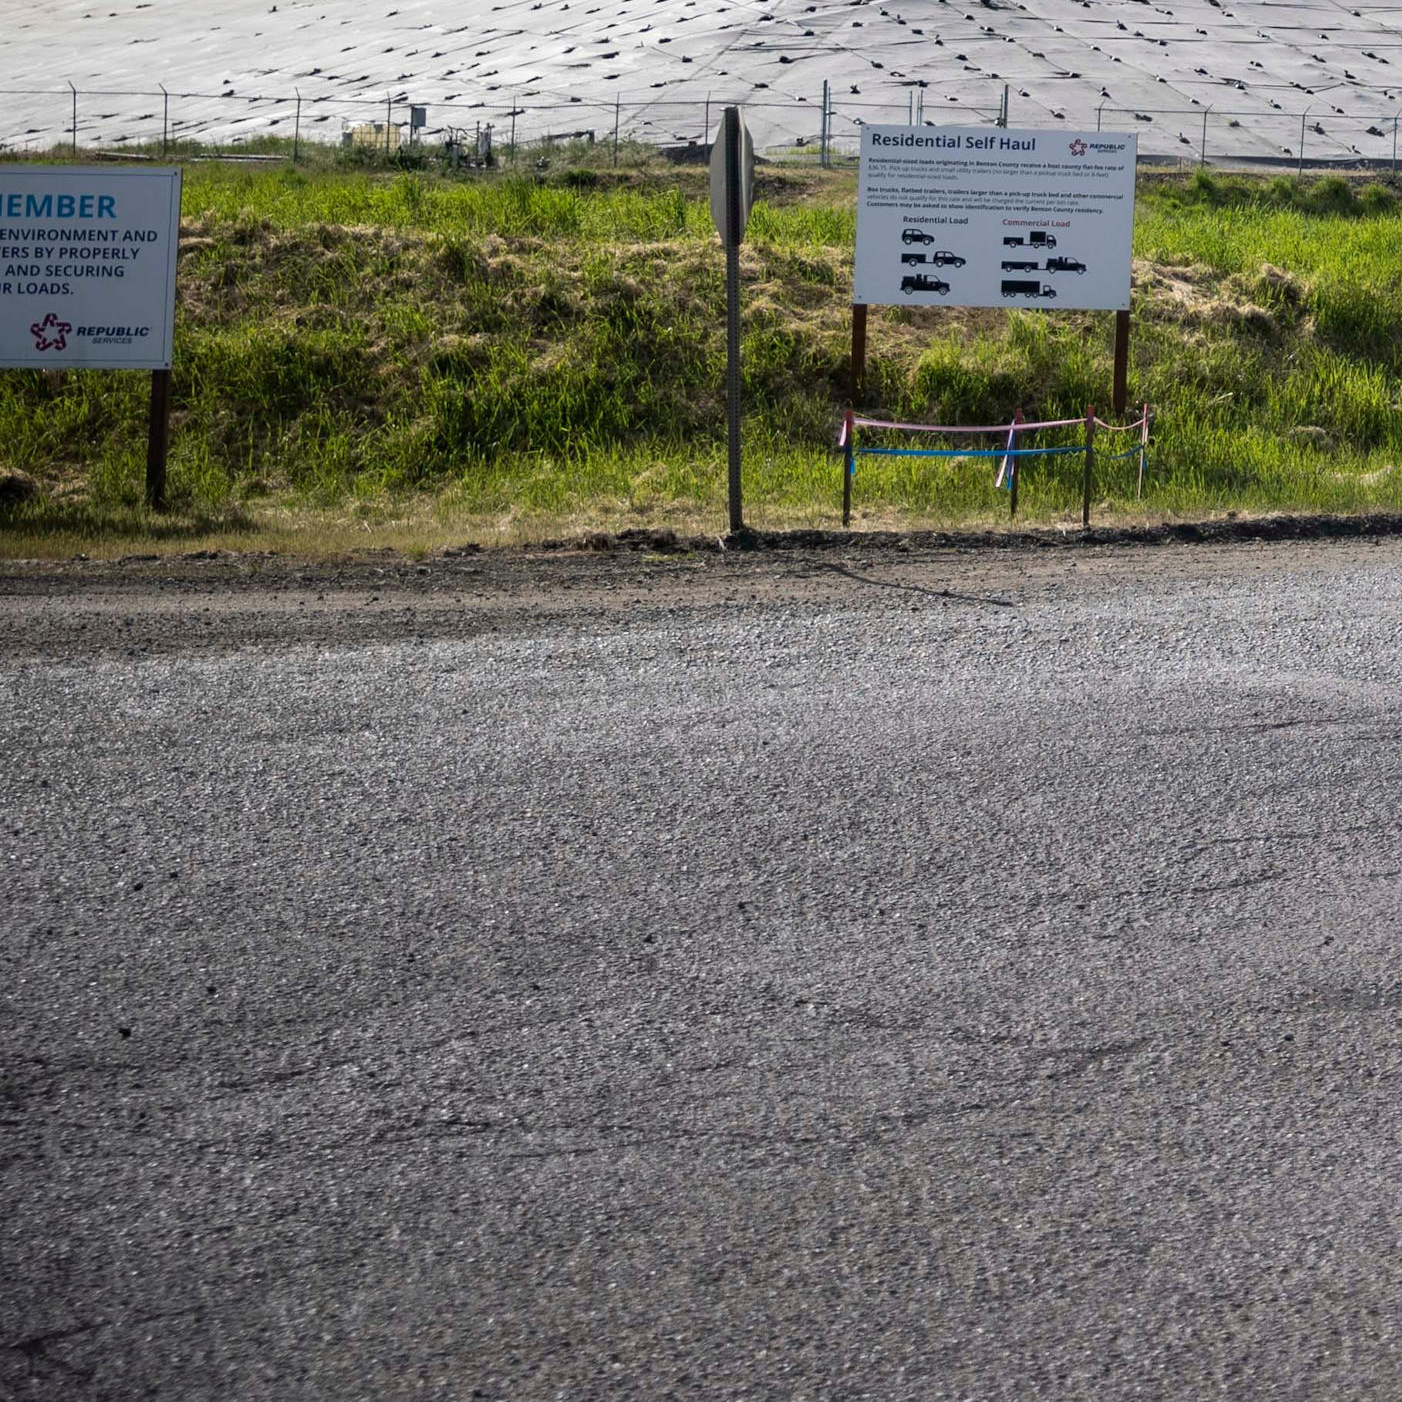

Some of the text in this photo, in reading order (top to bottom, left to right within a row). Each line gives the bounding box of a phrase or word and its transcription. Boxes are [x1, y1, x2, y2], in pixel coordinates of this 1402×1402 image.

[872, 133, 1036, 151] Residential Self Haul
[0, 194, 118, 219] EMBER
[903, 216, 969, 225] Residential Load
[1002, 218, 1071, 228] Commercial Load
[0, 228, 158, 243] ENVIRONMENT AND
[0, 246, 141, 260] ERS BY PROPERLY
[5, 264, 125, 278] AND SECURING
[17, 282, 74, 296] LOADS.
[76, 326, 149, 337] REPUBLIC
[92, 337, 133, 345] SERVICES
